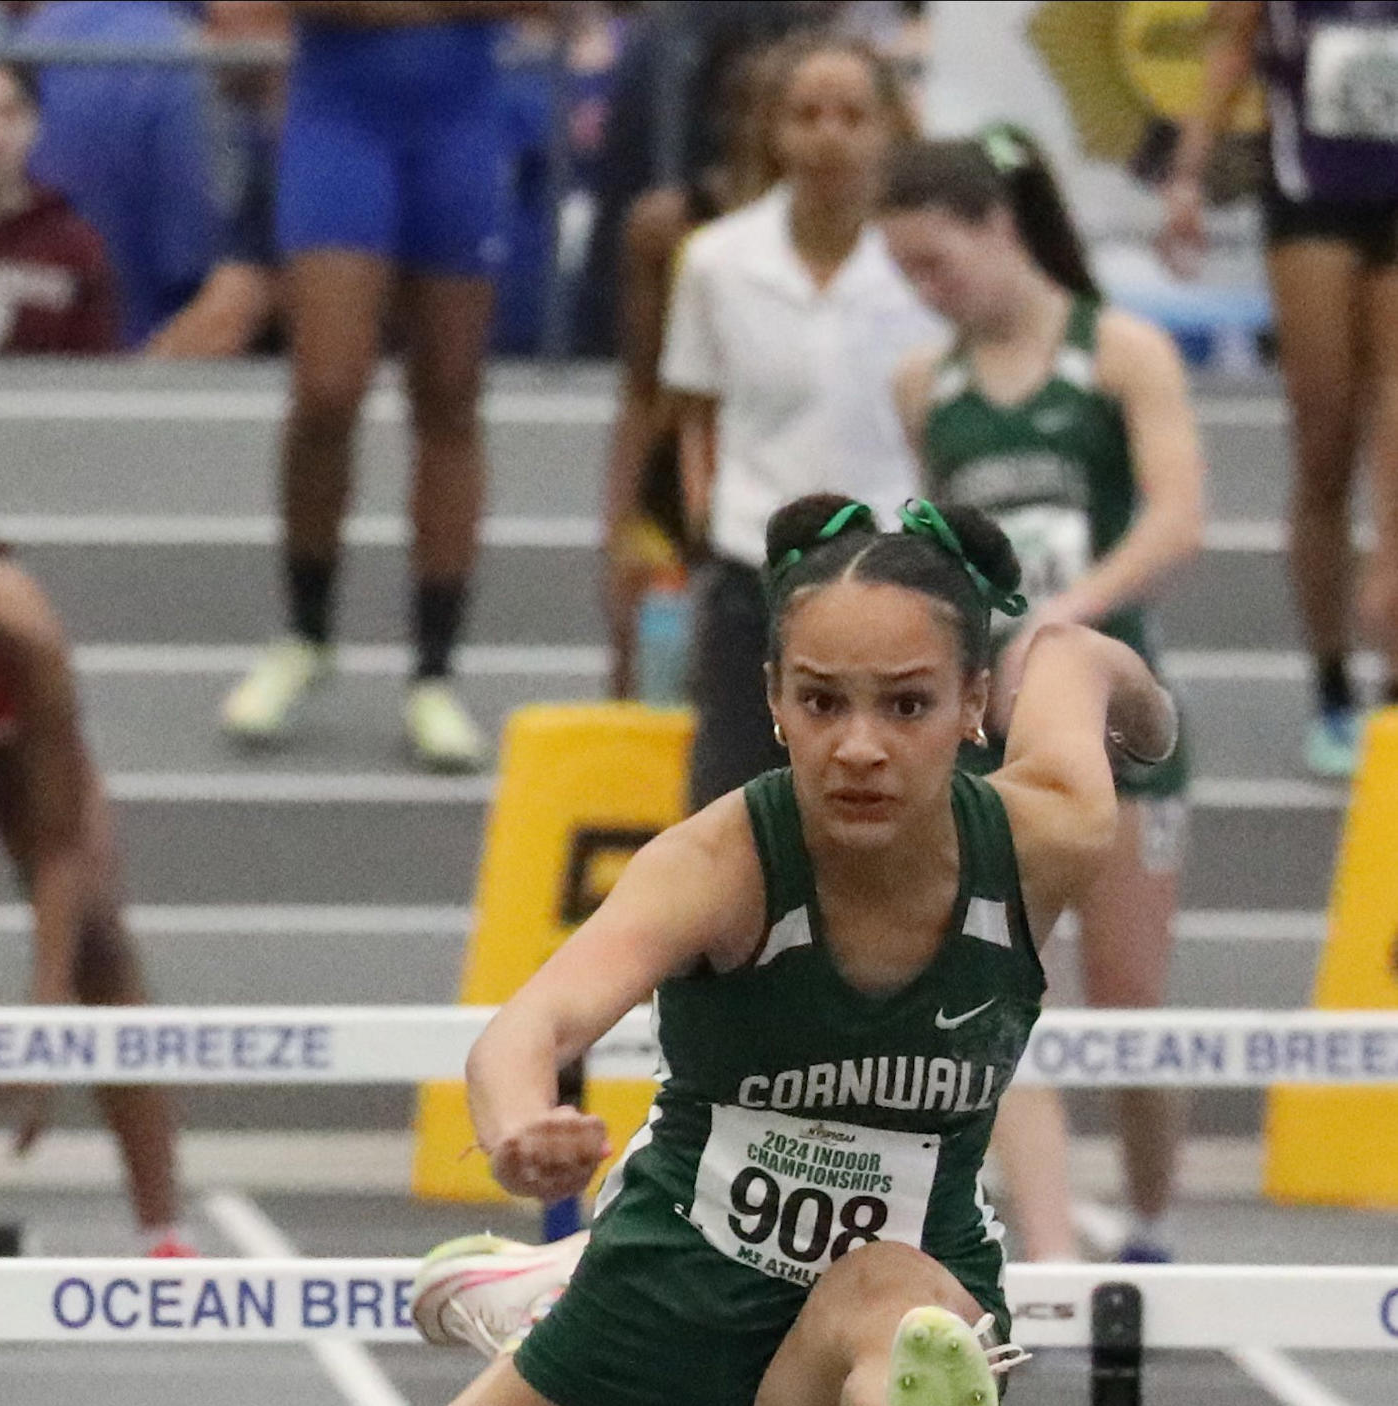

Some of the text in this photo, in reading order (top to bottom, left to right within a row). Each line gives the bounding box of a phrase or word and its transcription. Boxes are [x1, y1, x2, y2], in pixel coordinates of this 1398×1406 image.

[115, 1024, 332, 1070] BREEZE
[1032, 1030, 1398, 1075] OCEAN BREE
[738, 1056, 994, 1112] CORNWALL
[747, 1143, 893, 1194] CHAMPIONSHIPS
[763, 1130, 881, 1172] 2024 INDOOR
[728, 1166, 888, 1263] 908
[764, 1258, 822, 1284] ATHL
[52, 1277, 416, 1329] OCEAN BRE
